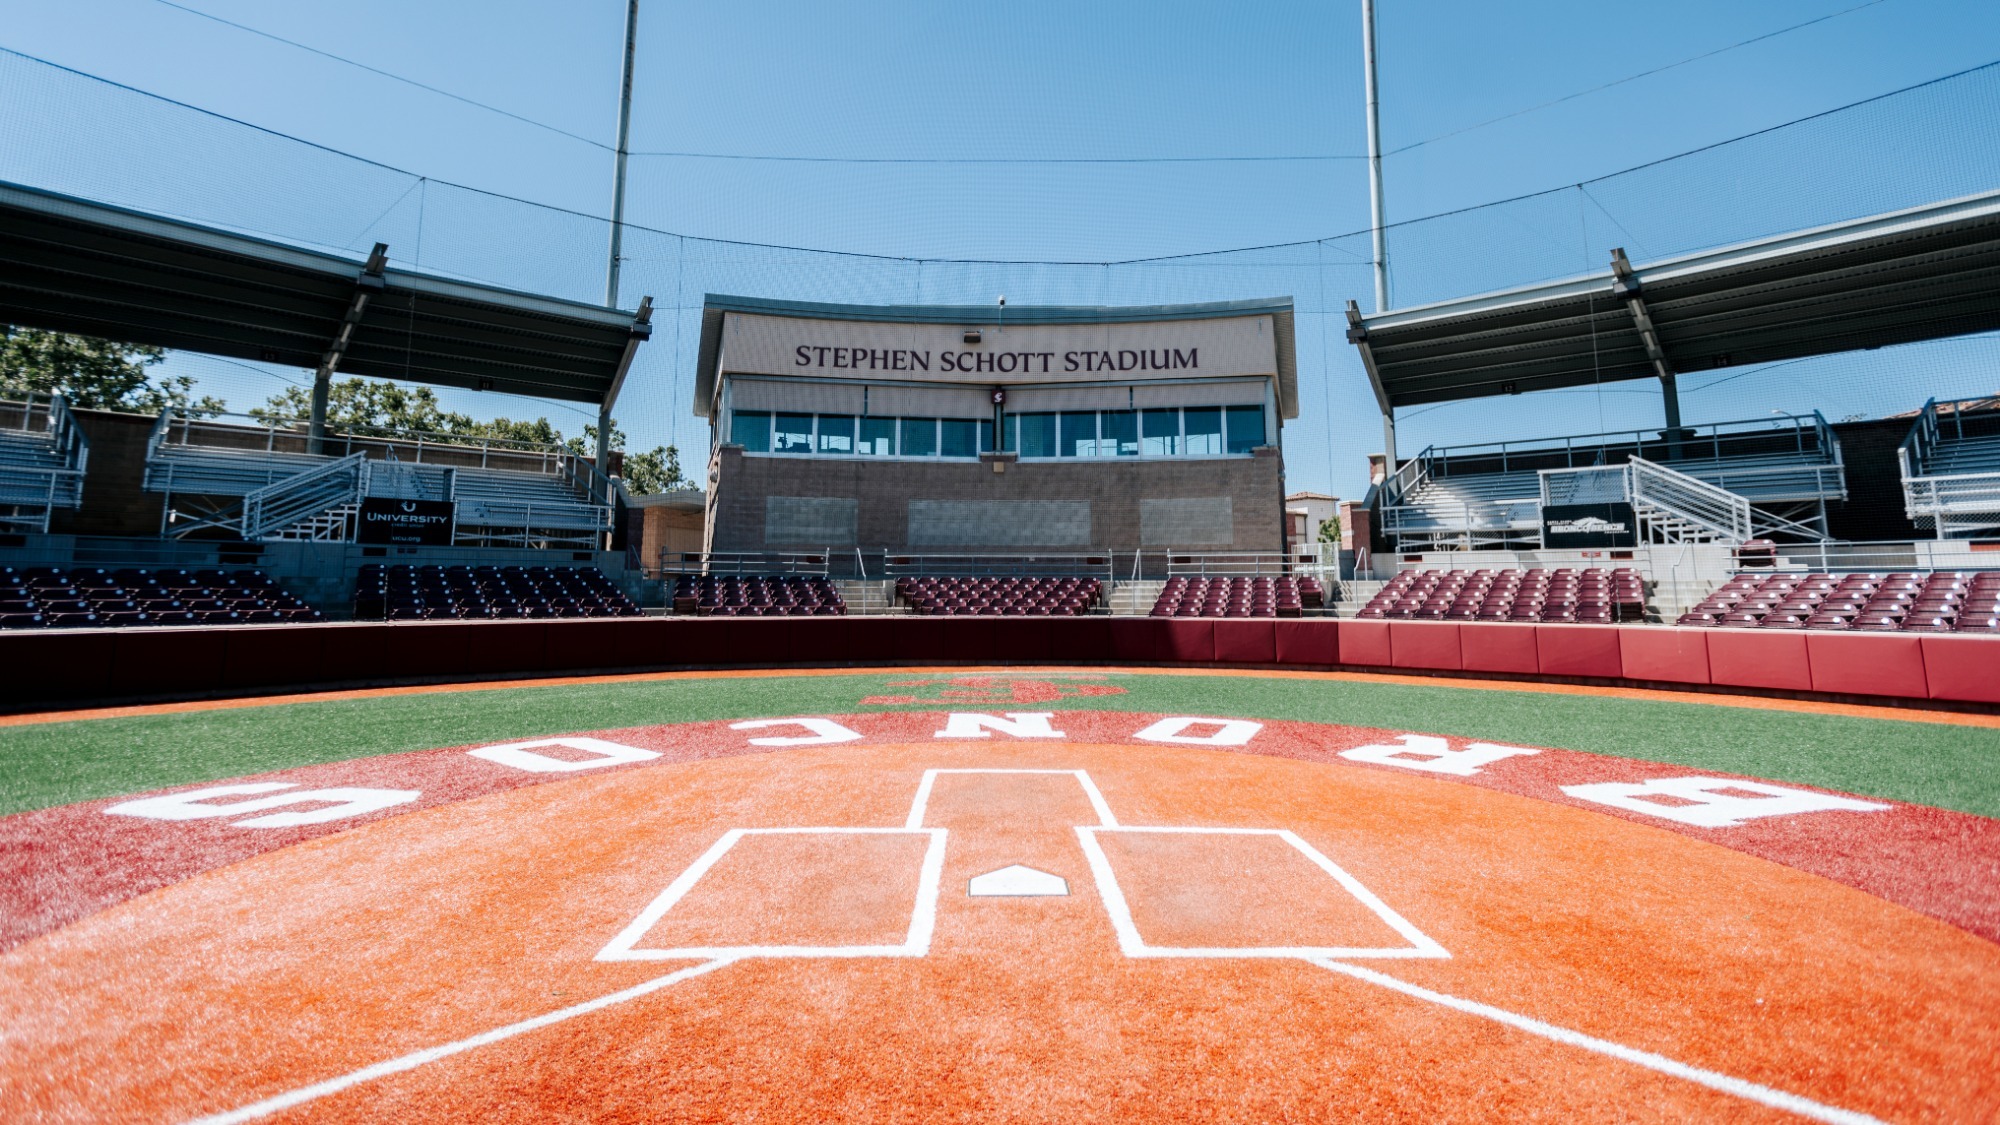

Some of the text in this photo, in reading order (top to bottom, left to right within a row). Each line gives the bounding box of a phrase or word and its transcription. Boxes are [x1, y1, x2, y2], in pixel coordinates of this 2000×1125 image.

[795, 345, 1198, 373] STEPHEN SCHOTT STADIUM
[367, 512, 447, 524] UNIVERSITY
[392, 535, 421, 543] ucu.org
